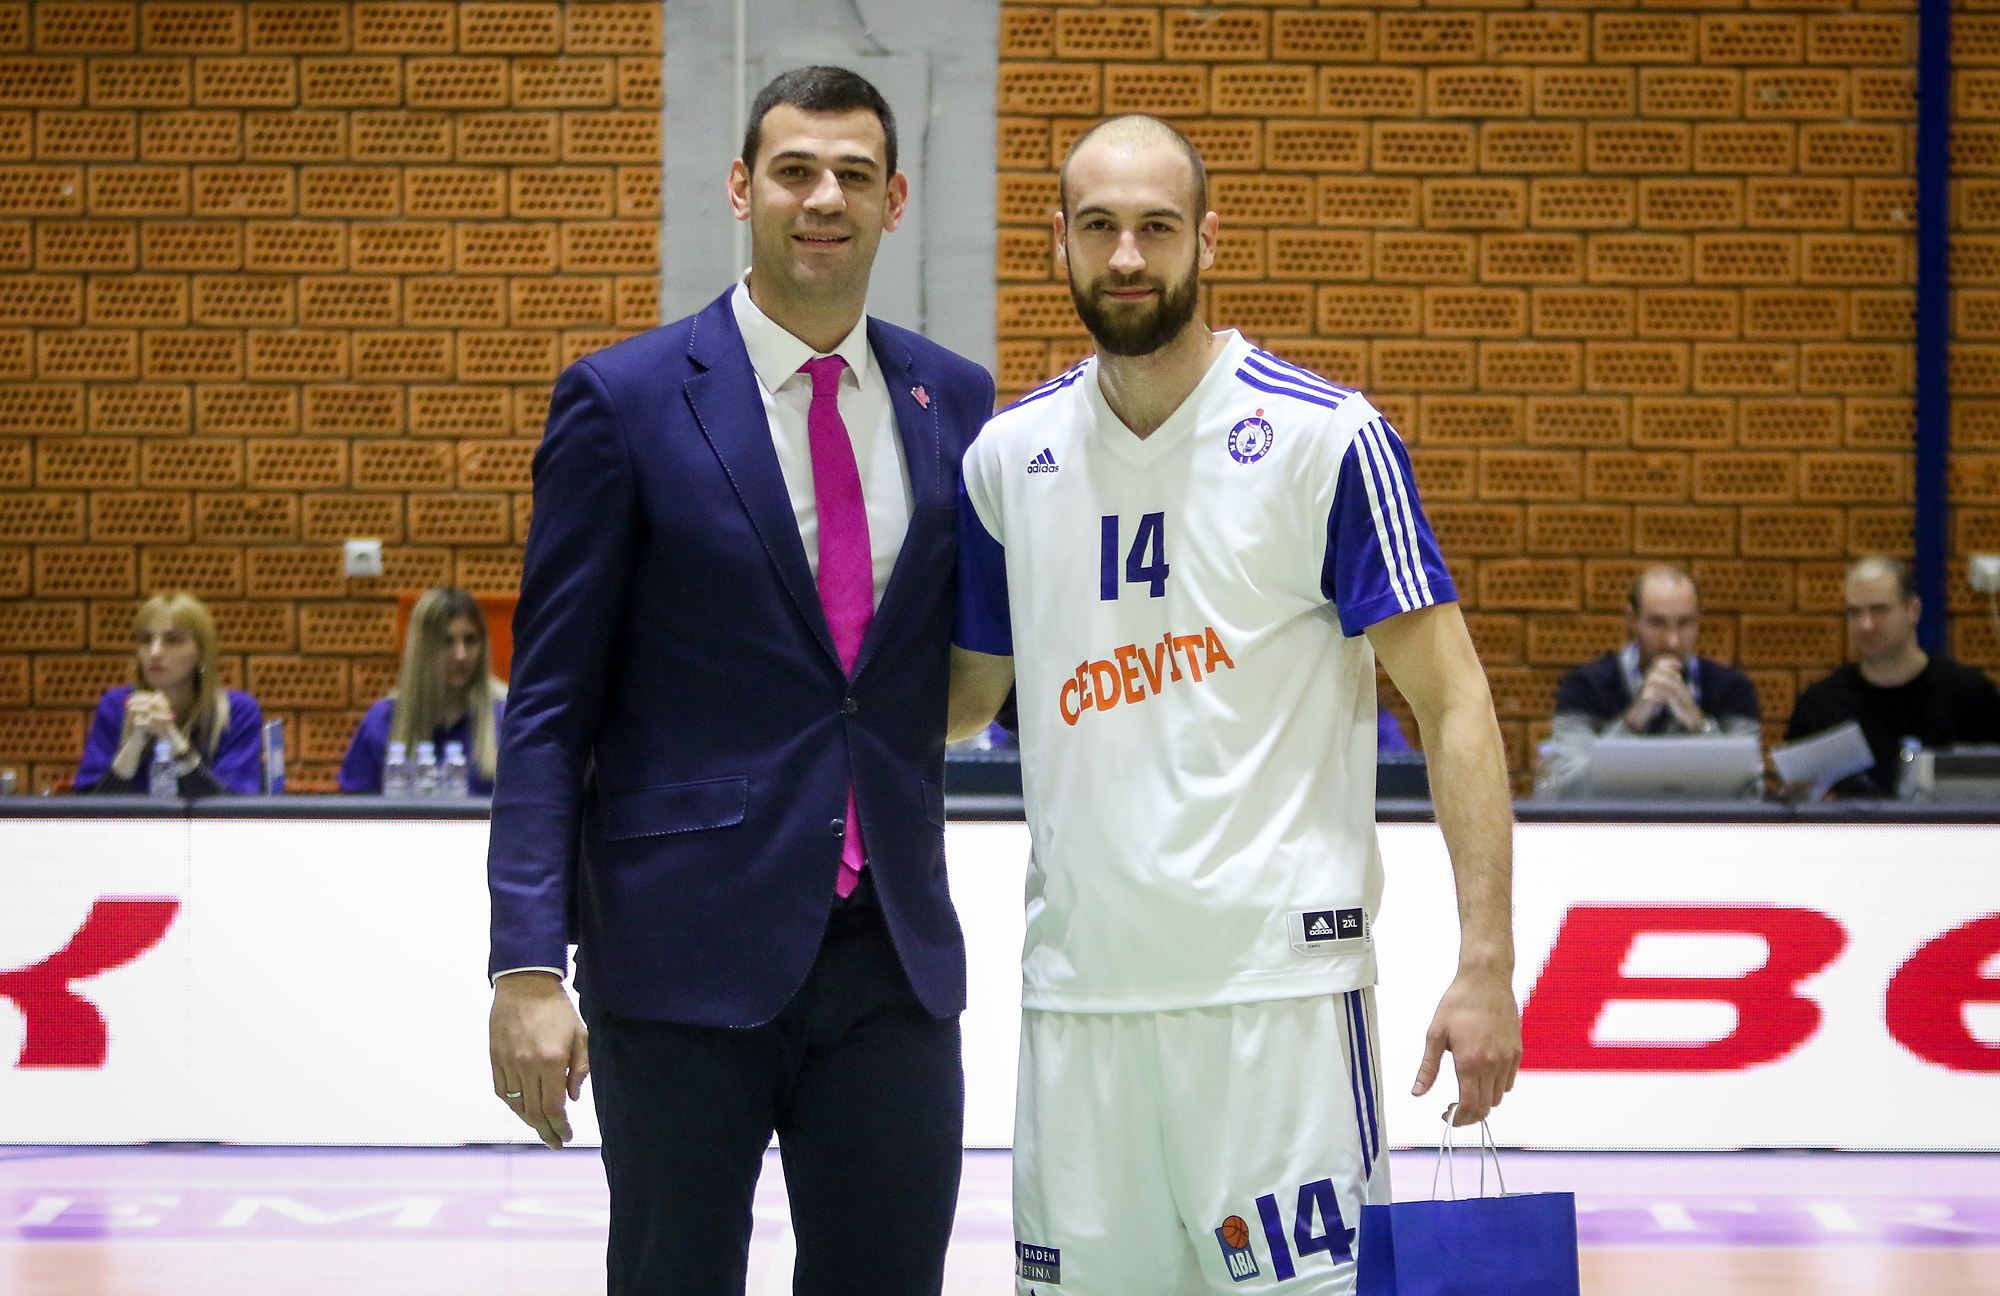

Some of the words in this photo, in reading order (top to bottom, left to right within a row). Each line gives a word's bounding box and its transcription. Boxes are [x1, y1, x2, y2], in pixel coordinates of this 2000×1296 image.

[1027, 463, 1060, 474] adidas
[1100, 511, 1170, 601] 14
[1059, 626, 1236, 727] CEDEVITA
[1309, 928, 1333, 936] adidas
[1342, 919, 1357, 929] 2XL
[1254, 1177, 1357, 1283] 14
[1024, 1248, 1056, 1263] BADEM
[1228, 1250, 1258, 1278] ABA
